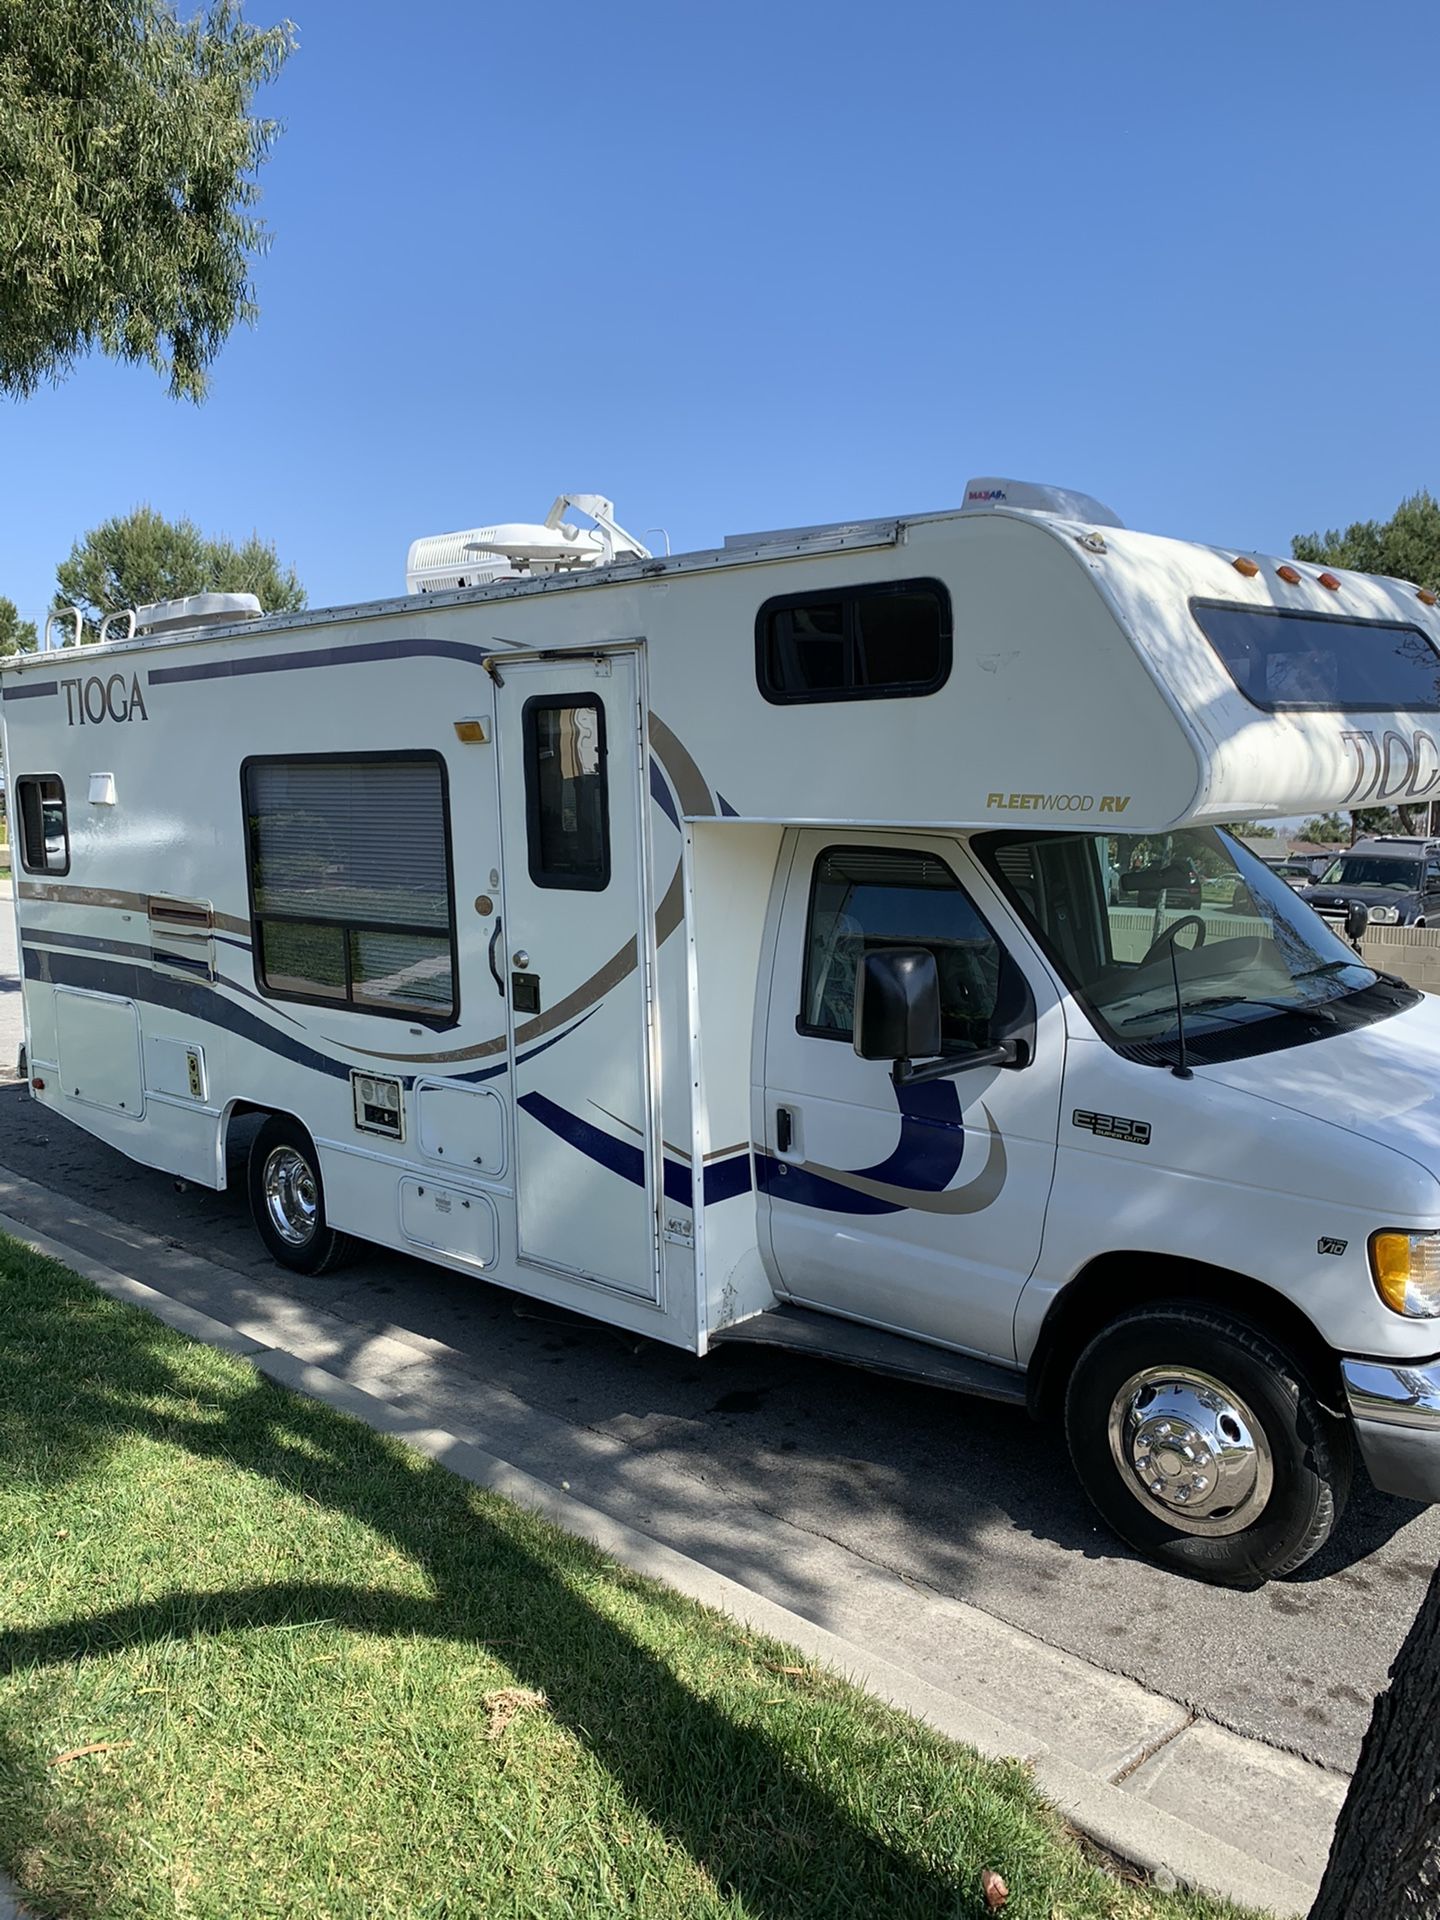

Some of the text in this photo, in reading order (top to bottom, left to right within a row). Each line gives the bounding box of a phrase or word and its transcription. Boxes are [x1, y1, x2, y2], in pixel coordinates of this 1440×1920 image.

[60, 671, 149, 726] TIOGA
[986, 793, 1131, 812] FLEETWOOD RV
